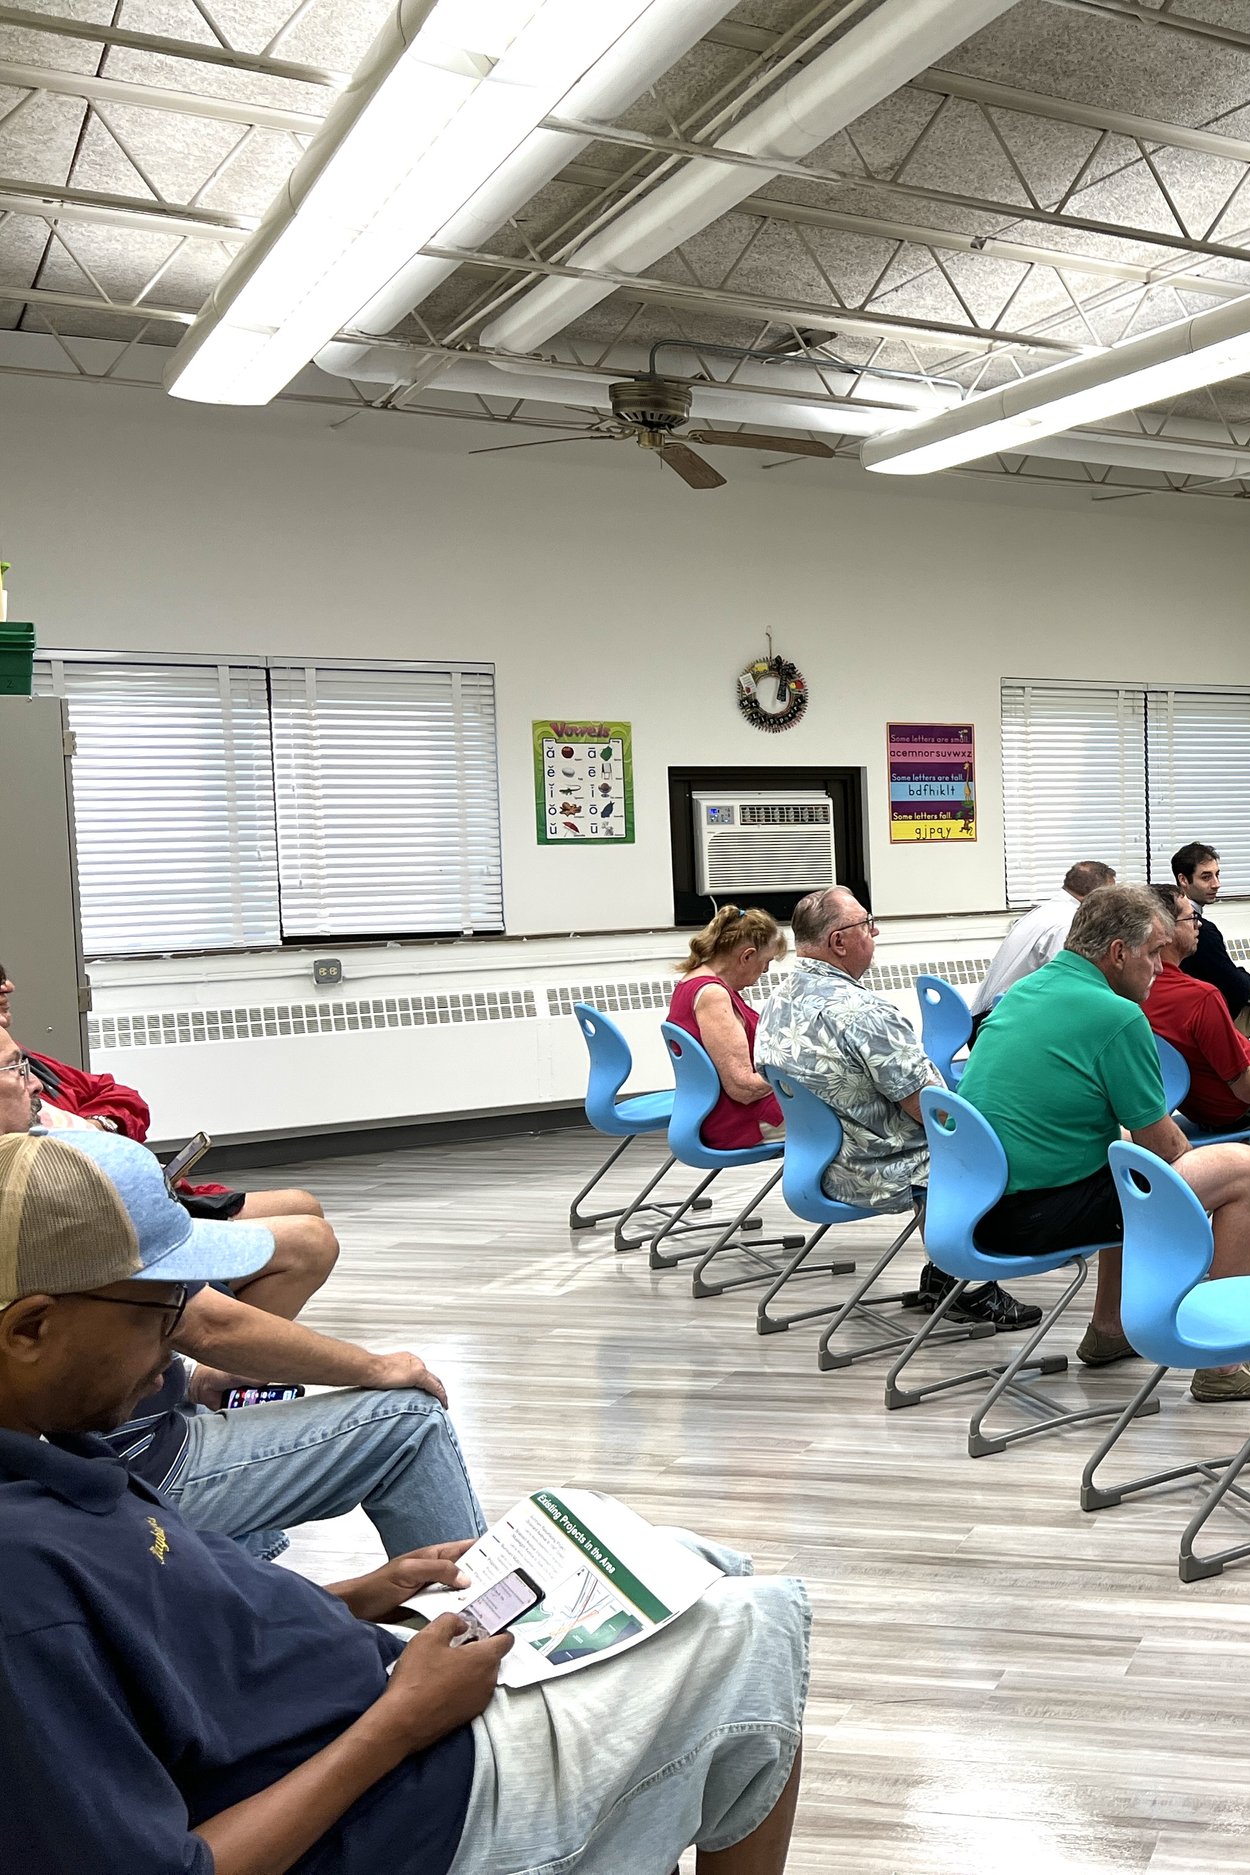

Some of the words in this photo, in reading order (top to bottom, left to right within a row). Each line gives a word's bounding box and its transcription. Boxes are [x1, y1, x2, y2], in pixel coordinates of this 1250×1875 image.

[550, 723, 611, 737] Vowels
[912, 734, 934, 742] letters
[537, 1494, 562, 1520] Existing
[560, 1515, 586, 1544] Projects
[584, 1540, 593, 1550] in
[591, 1547, 602, 1560] the
[599, 1557, 615, 1573] Area
